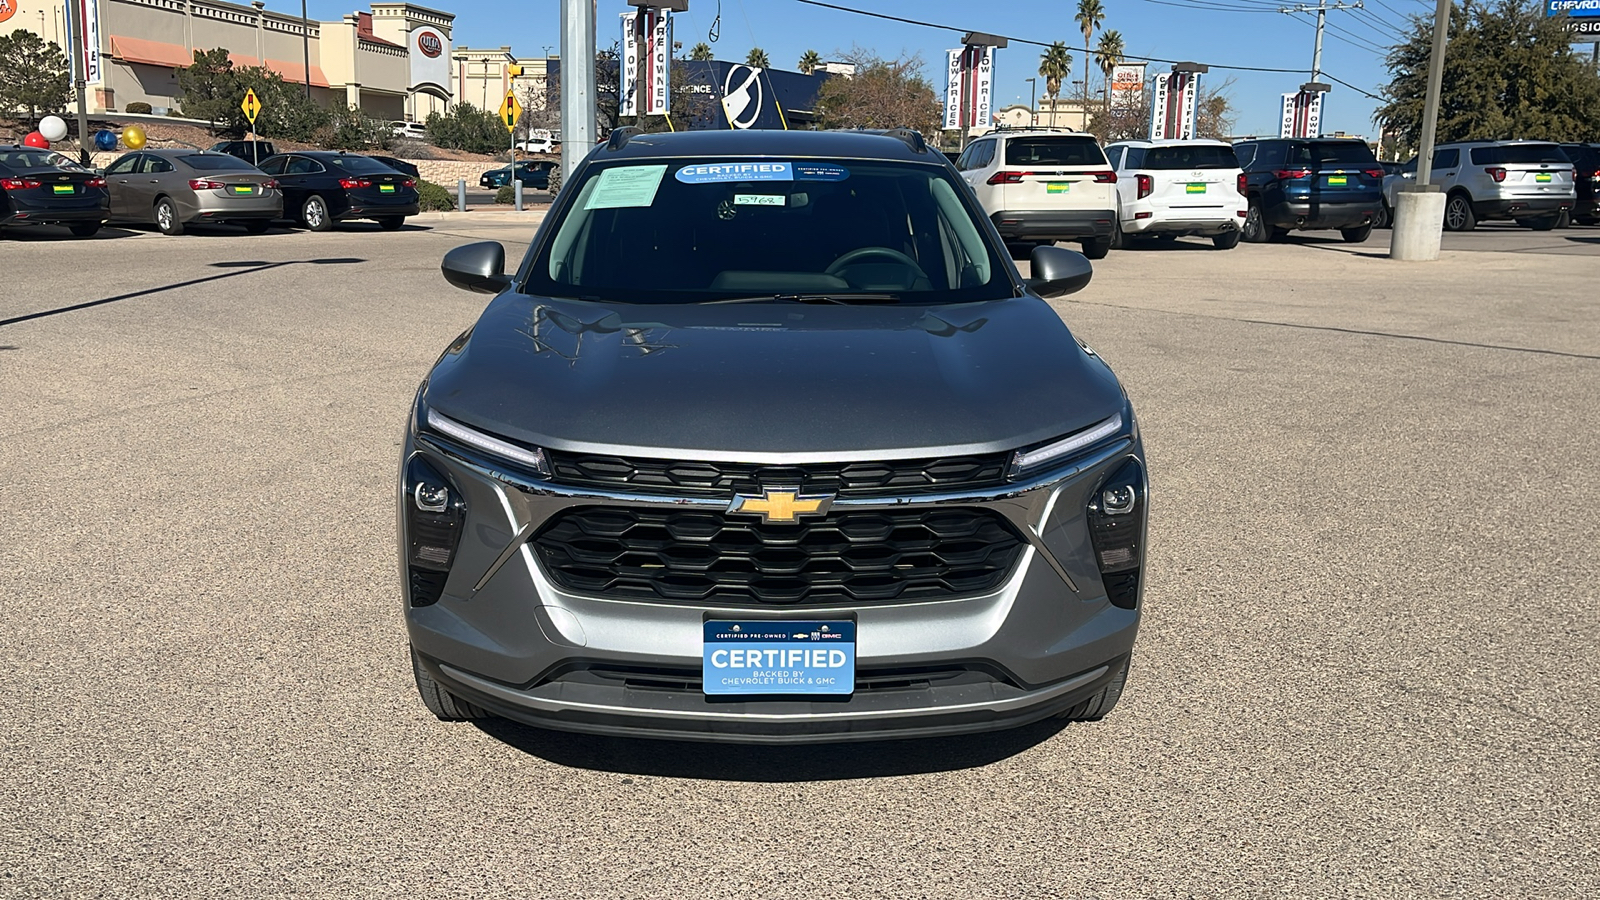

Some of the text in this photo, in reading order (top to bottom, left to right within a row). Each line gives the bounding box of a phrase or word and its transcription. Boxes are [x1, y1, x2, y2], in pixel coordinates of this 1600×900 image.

[1551, 0, 1600, 10] CHEVRO
[655, 16, 665, 108] PRE OWNED
[949, 53, 960, 126] LOW PRICES
[978, 50, 990, 125] LOW PRICES
[1155, 76, 1166, 137] CERTIFIED
[1183, 75, 1195, 137] CERTIFIED
[682, 164, 786, 176] CERTIFIED
[711, 649, 847, 668] CERTIFIED
